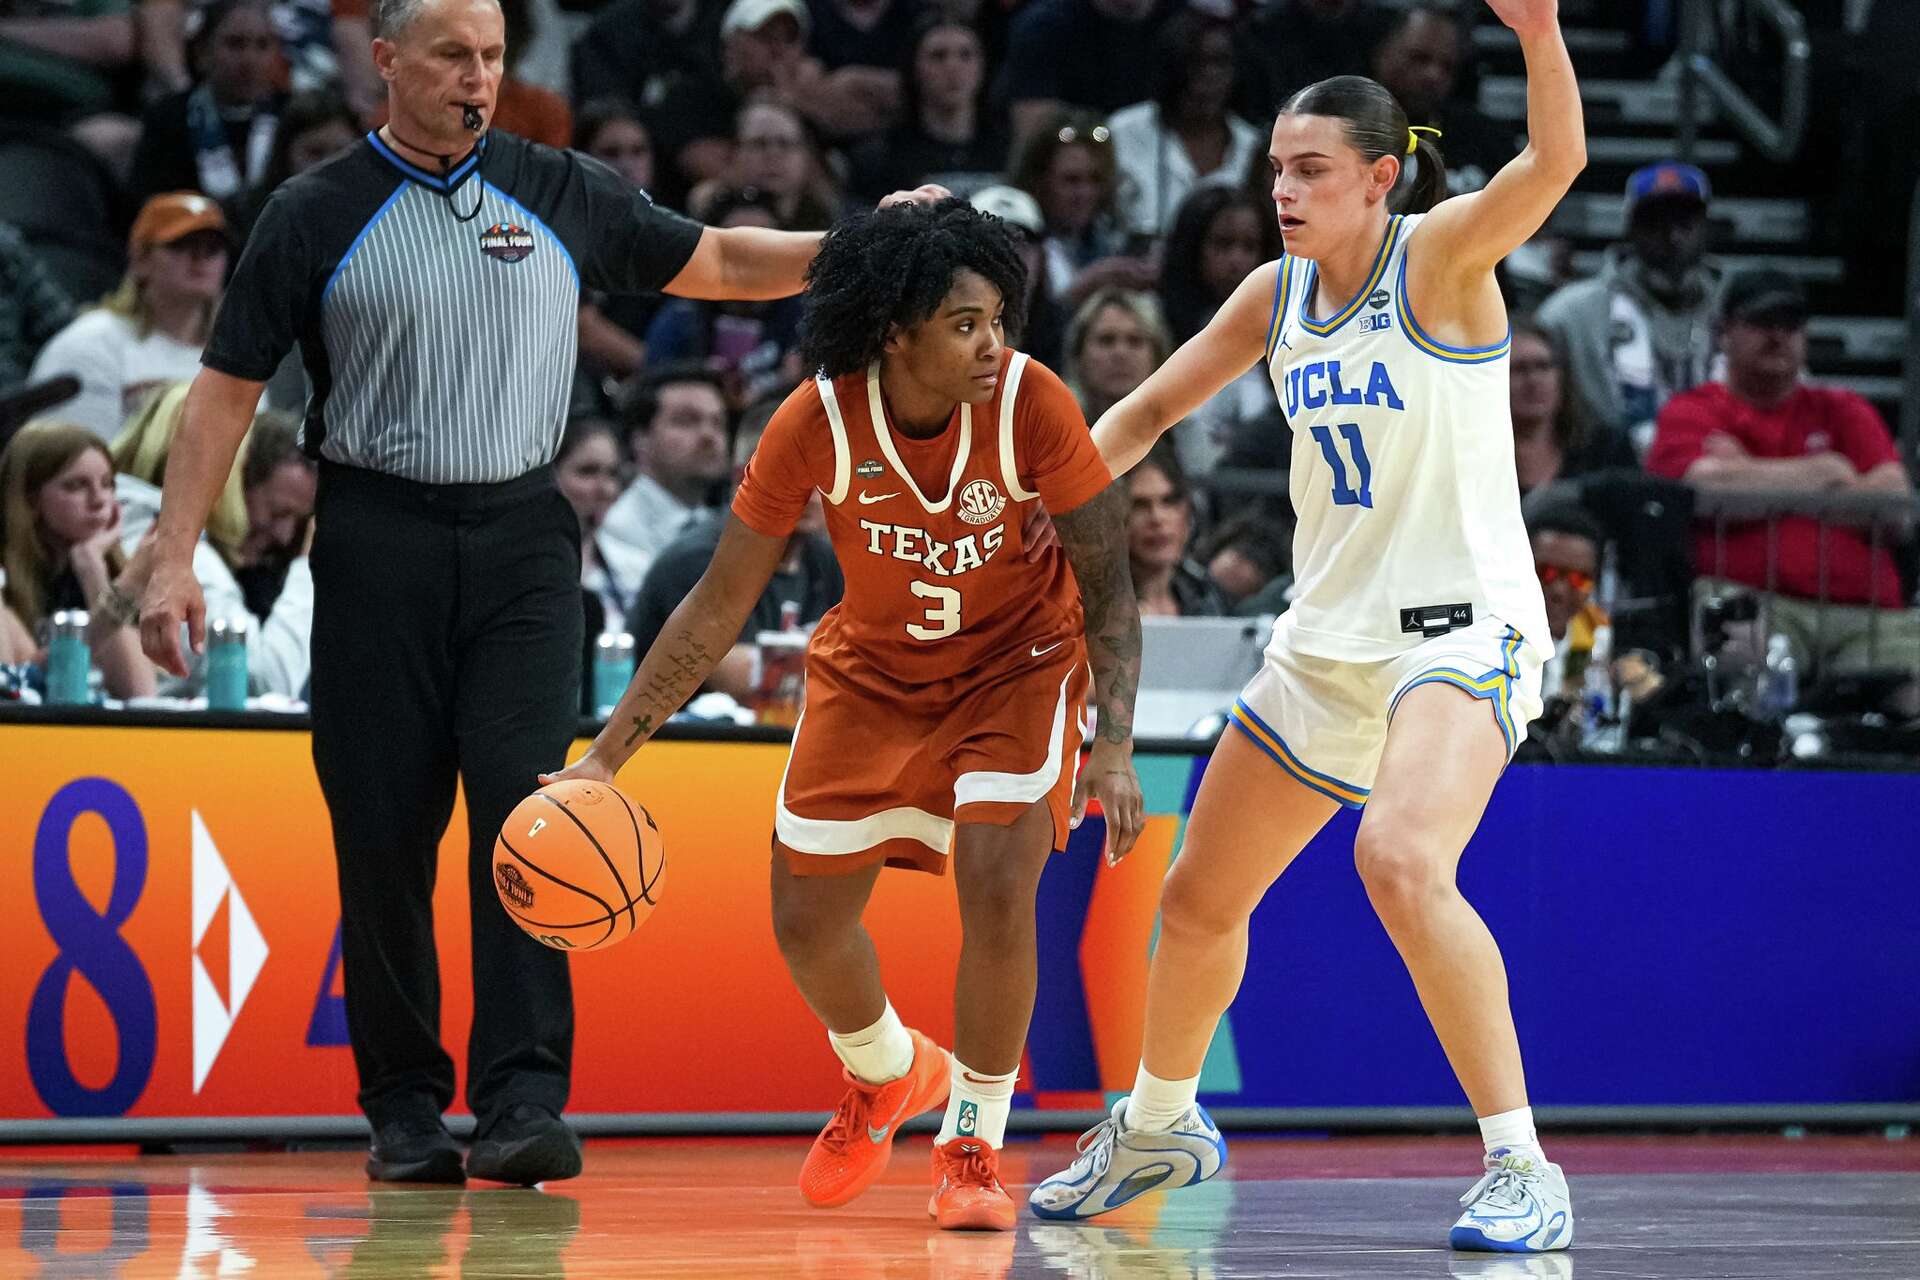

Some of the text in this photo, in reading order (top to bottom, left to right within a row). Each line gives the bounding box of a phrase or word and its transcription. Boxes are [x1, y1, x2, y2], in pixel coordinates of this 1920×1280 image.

[1285, 361, 1405, 418] UCLA
[1309, 423, 1373, 508] 11
[962, 481, 996, 514] SEC
[964, 503, 1003, 524] GRADUATE
[859, 519, 1005, 576] TEXAS
[905, 580, 962, 641] 3
[1453, 609, 1467, 620] 44
[25, 776, 158, 1118] 8
